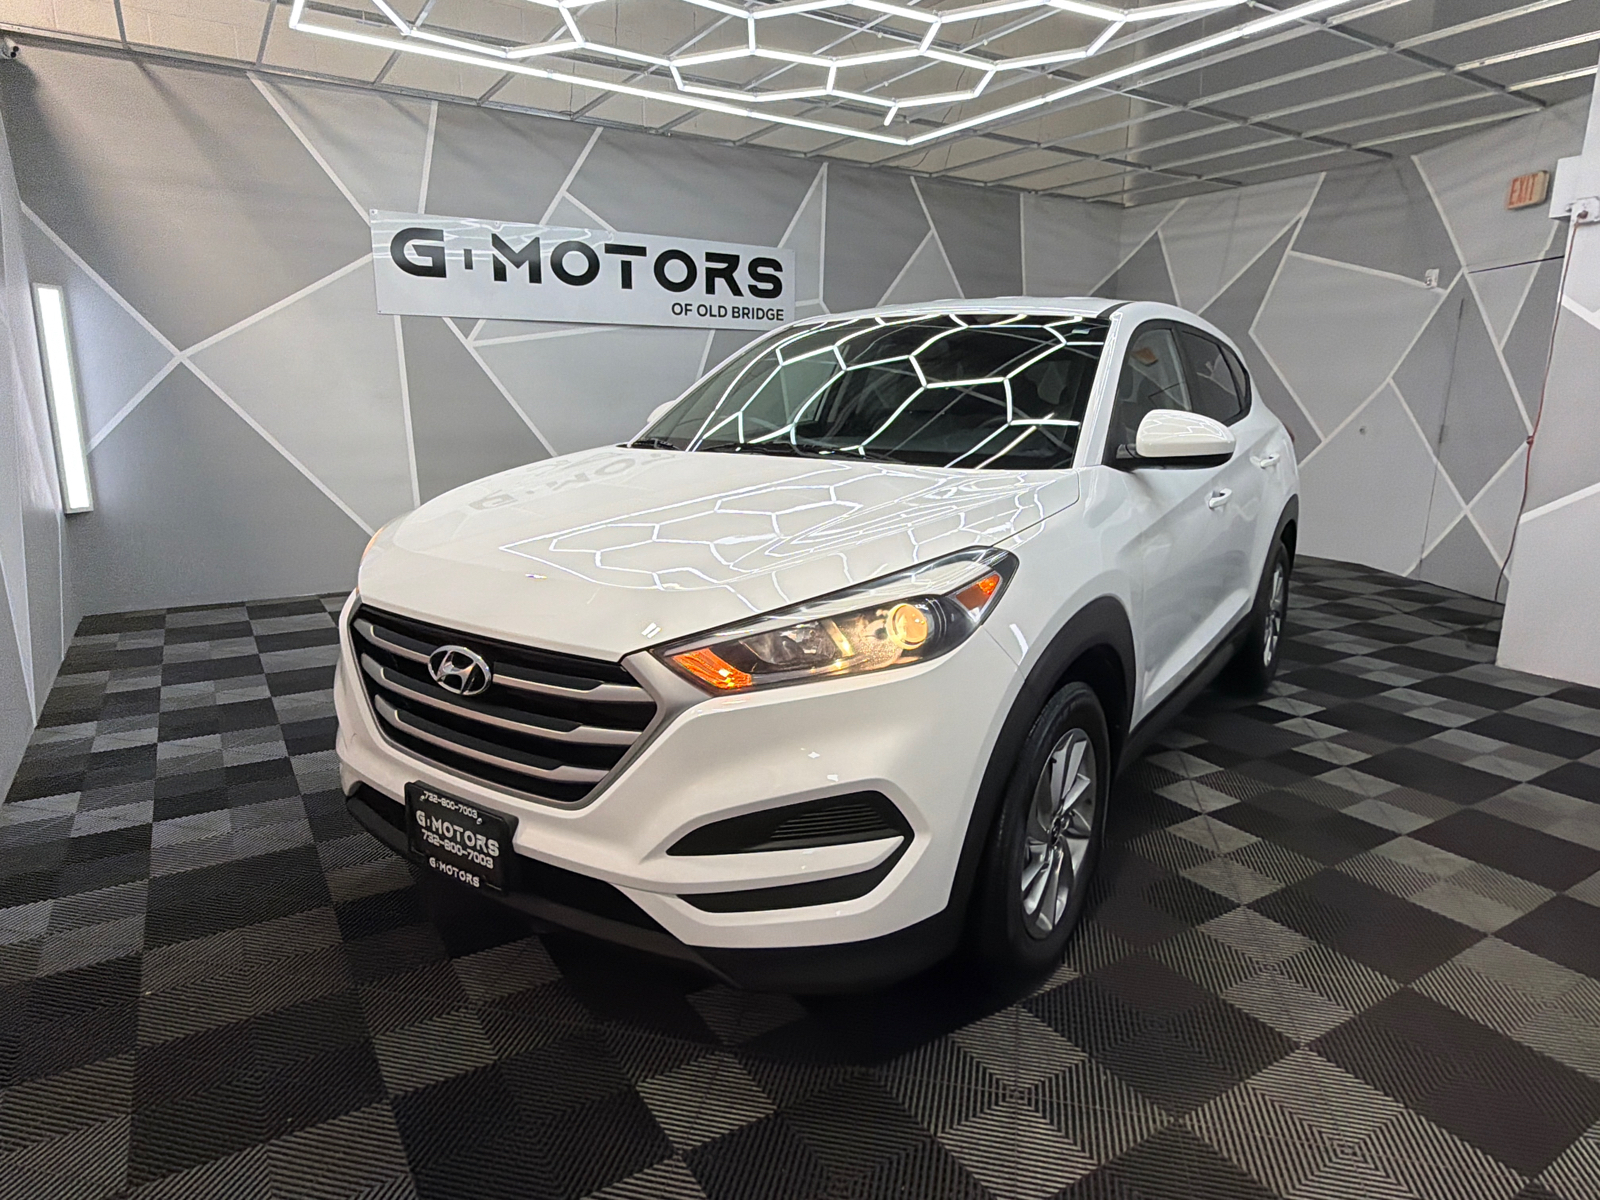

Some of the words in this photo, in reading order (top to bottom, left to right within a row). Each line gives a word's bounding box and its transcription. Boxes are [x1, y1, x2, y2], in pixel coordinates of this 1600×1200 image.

[1508, 174, 1539, 207] EXIT
[671, 303, 693, 316] OF
[697, 304, 728, 318] OLD
[732, 306, 784, 321] BRIDGE
[423, 791, 478, 819] 732-800-7003
[421, 829, 494, 869] 732-800-7003
